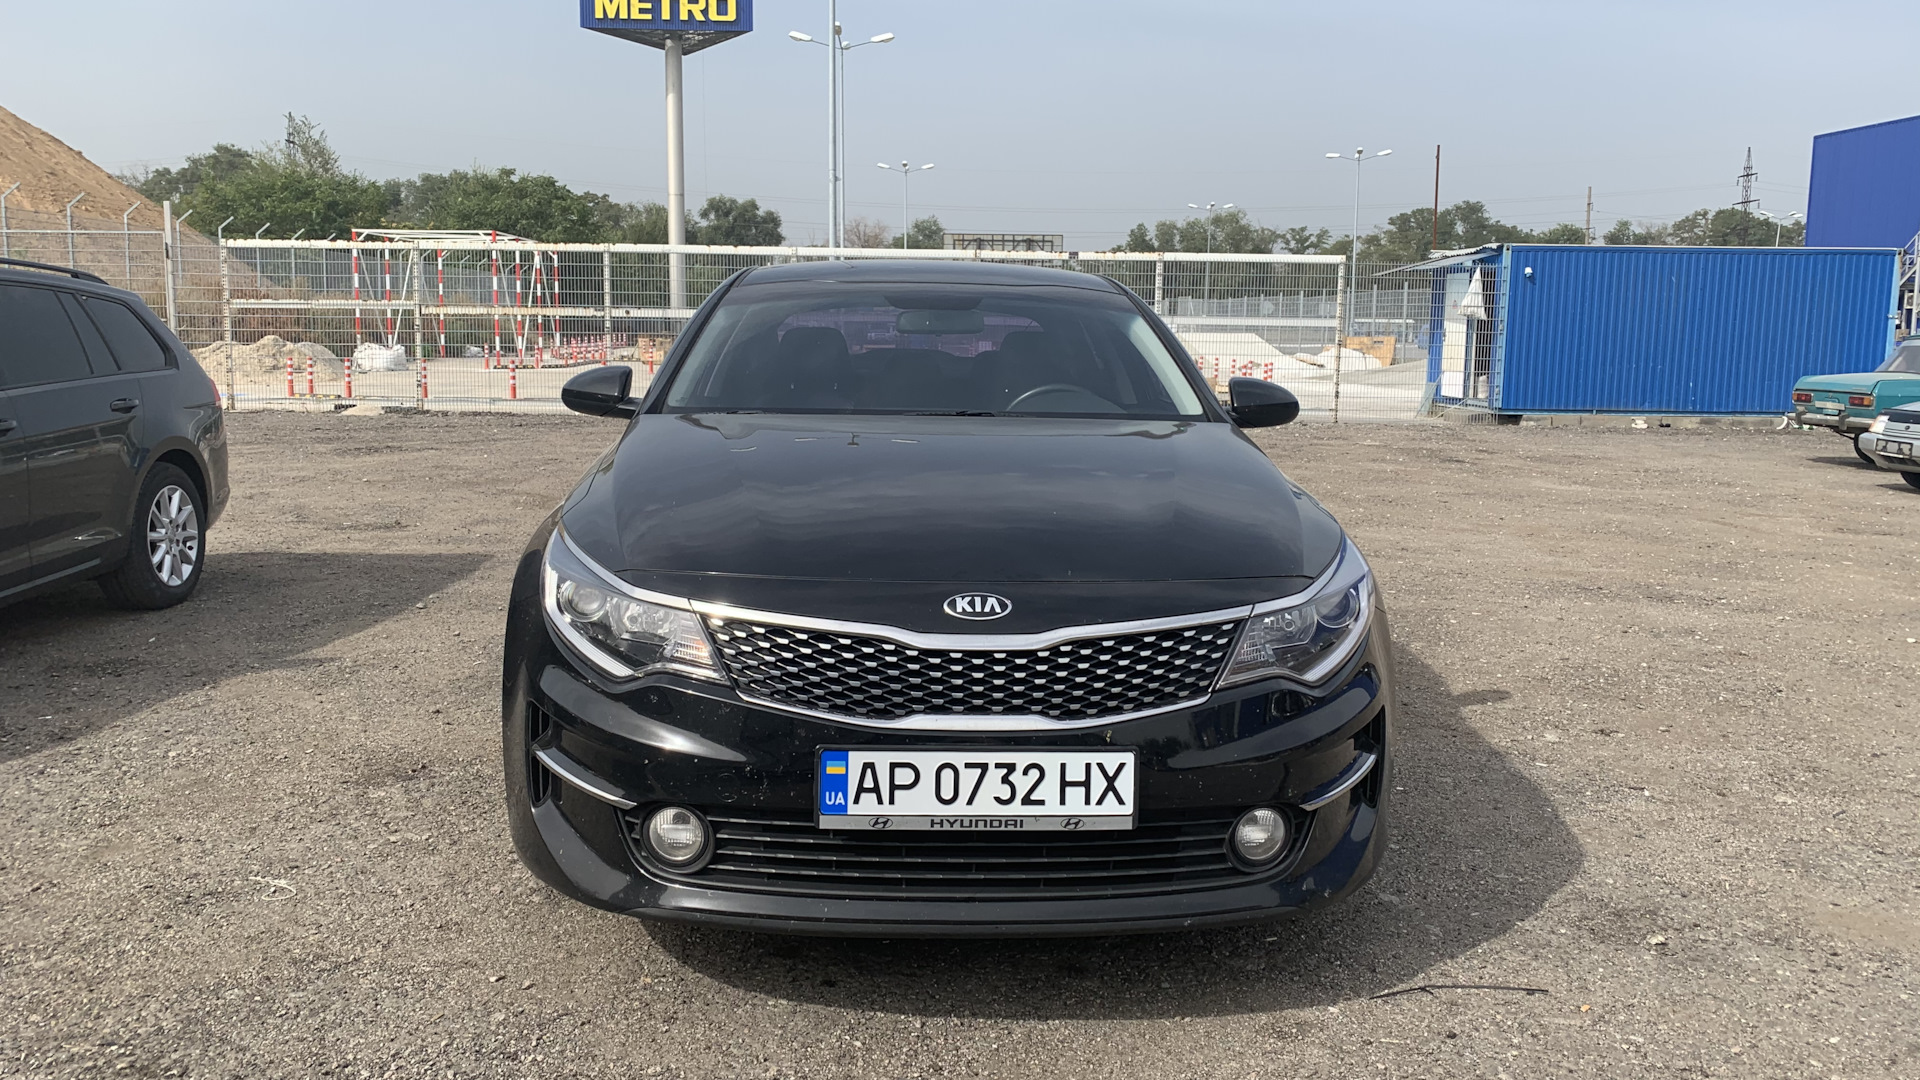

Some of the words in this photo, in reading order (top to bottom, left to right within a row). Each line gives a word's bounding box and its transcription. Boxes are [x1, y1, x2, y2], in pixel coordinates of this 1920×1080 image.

[594, 0, 737, 22] METRO
[955, 596, 1002, 613] KIA
[853, 761, 921, 806] AP
[934, 761, 1046, 806] 0732
[1059, 761, 1127, 806] HX
[825, 791, 846, 805] UA
[930, 818, 1024, 829] HYUNDAI
